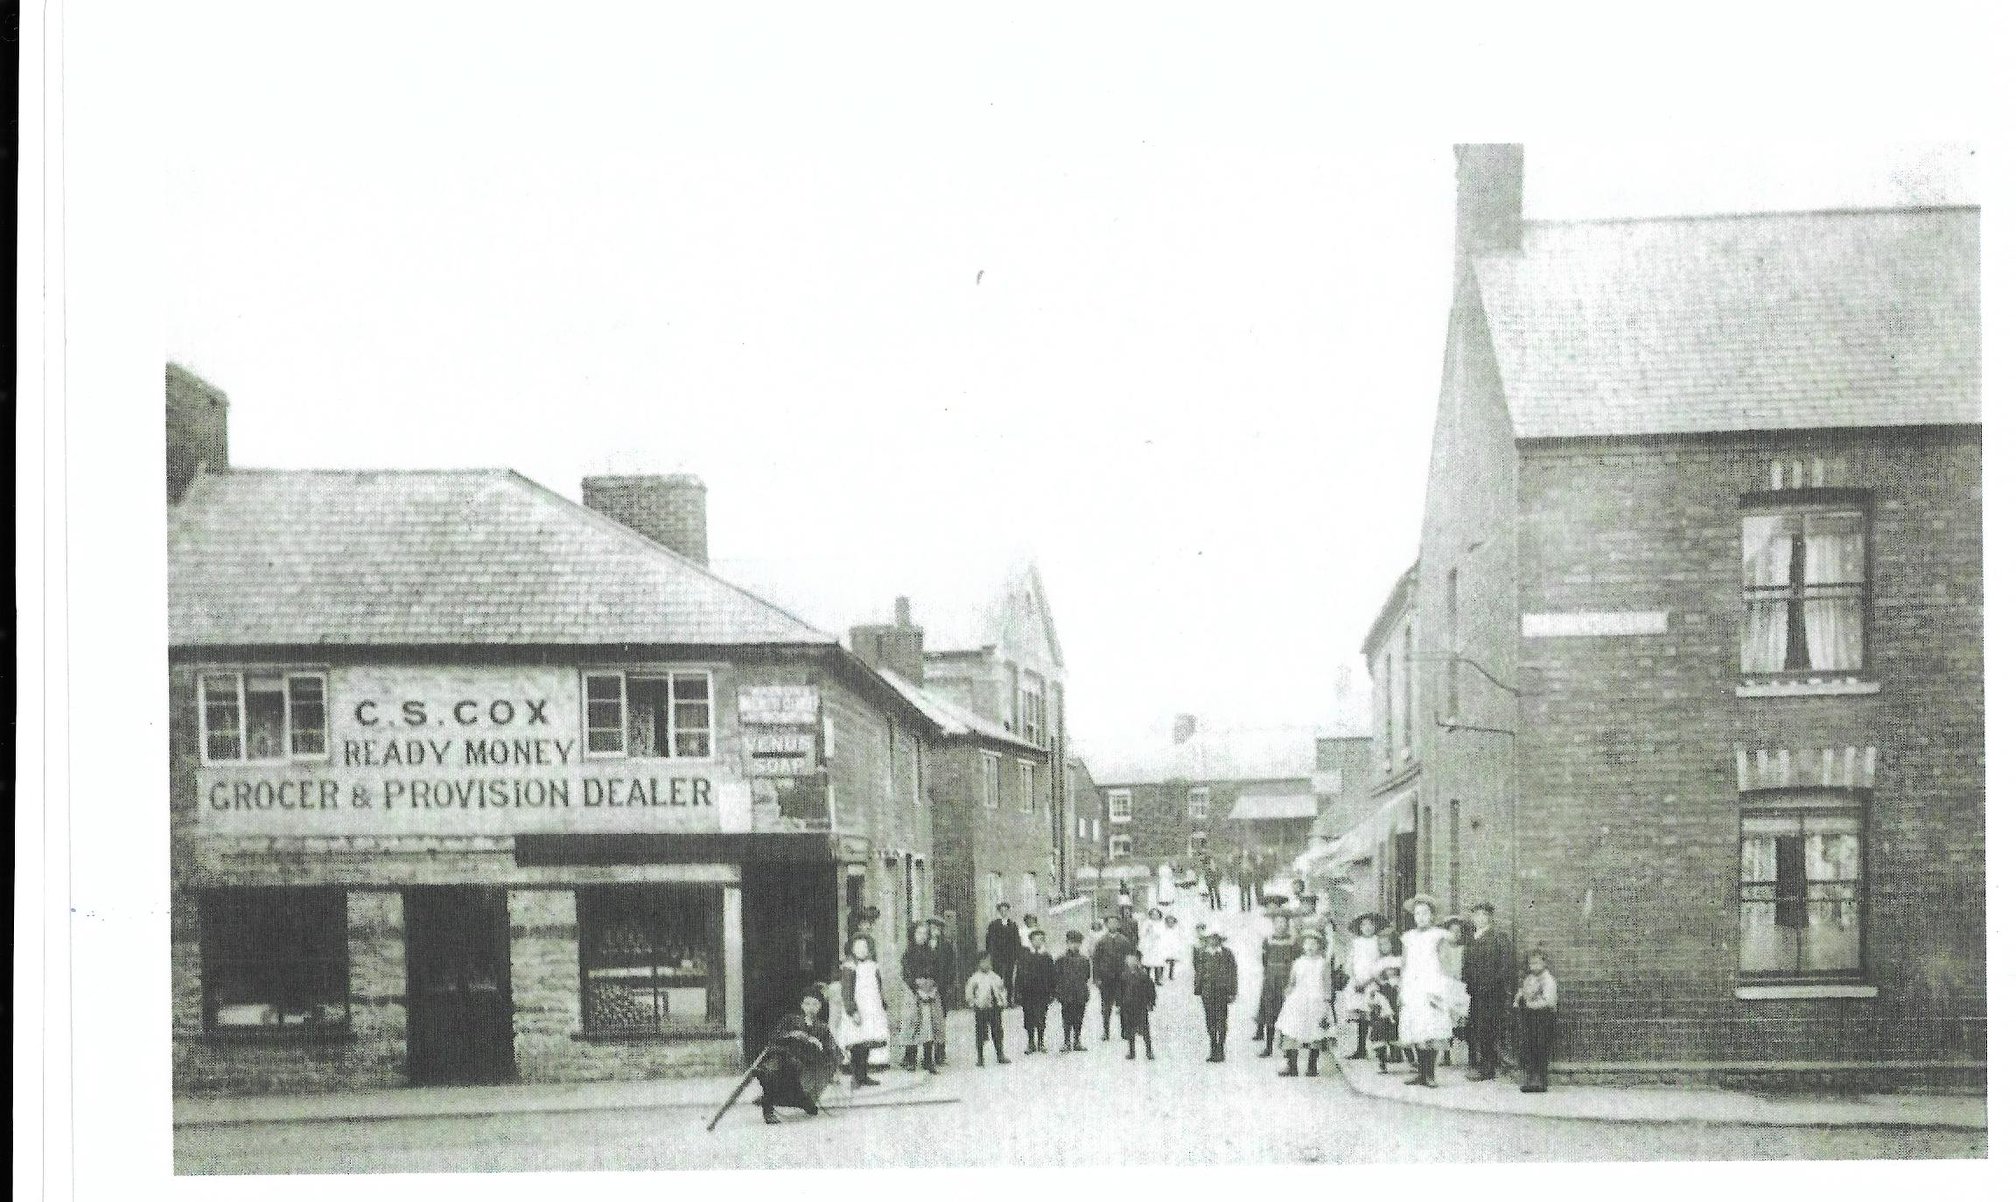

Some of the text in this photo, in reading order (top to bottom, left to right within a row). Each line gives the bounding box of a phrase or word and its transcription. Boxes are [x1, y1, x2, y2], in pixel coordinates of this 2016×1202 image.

[344, 738, 576, 767] READY MONEY
[742, 736, 811, 752] VENUS
[753, 758, 806, 775] SOAP
[208, 776, 713, 811] GROCER & PROVISION DEALER
